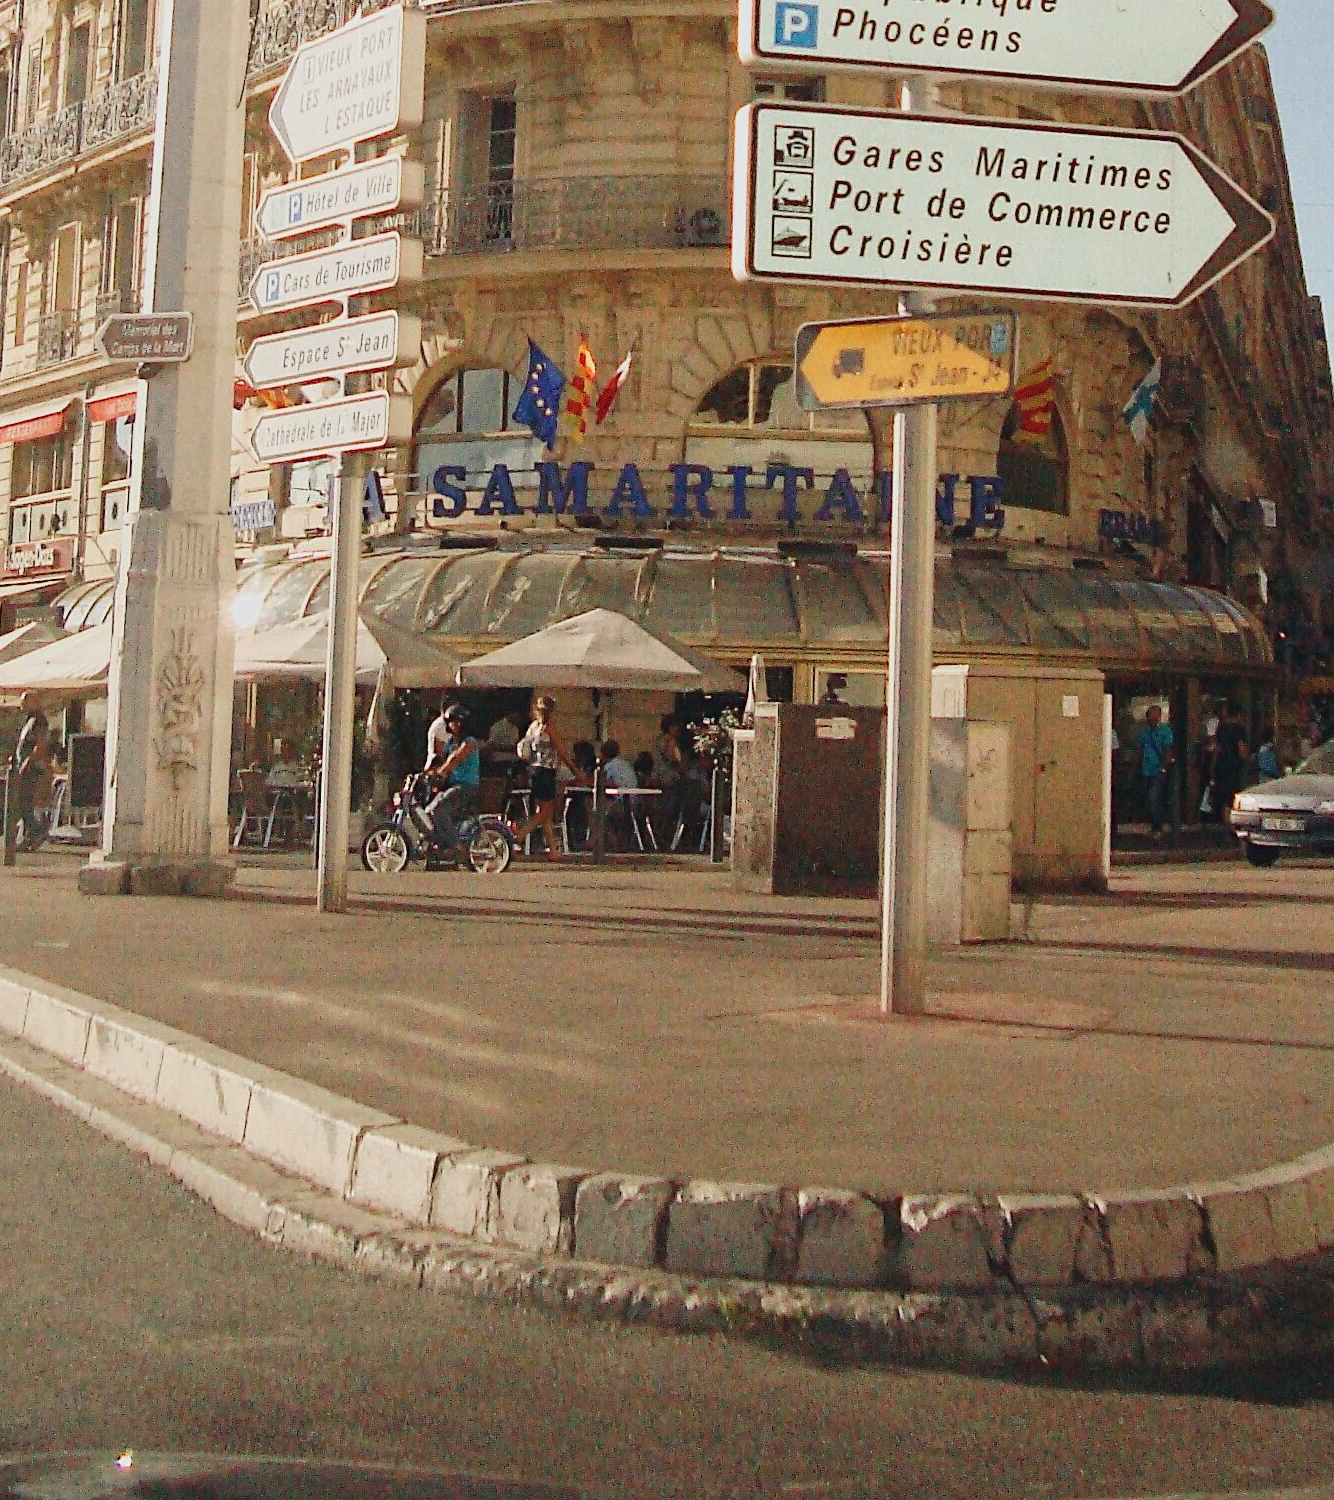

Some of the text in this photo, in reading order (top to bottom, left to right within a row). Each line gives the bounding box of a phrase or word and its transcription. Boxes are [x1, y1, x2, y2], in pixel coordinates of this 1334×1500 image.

[832, 8, 1023, 54] Phocéens
[318, 44, 353, 77] VIEUX
[300, 88, 320, 113] LES
[832, 135, 1173, 193] Gares Maritimes
[344, 181, 359, 203] de
[366, 173, 393, 199] Ville
[829, 179, 1172, 236] Port de Commerce
[829, 224, 1014, 268] Croisière
[283, 272, 310, 294] Cars
[315, 266, 330, 286] de
[335, 253, 392, 282] Tourisme
[282, 345, 330, 371] Espace
[355, 332, 389, 354] Jean
[320, 415, 332, 438] de
